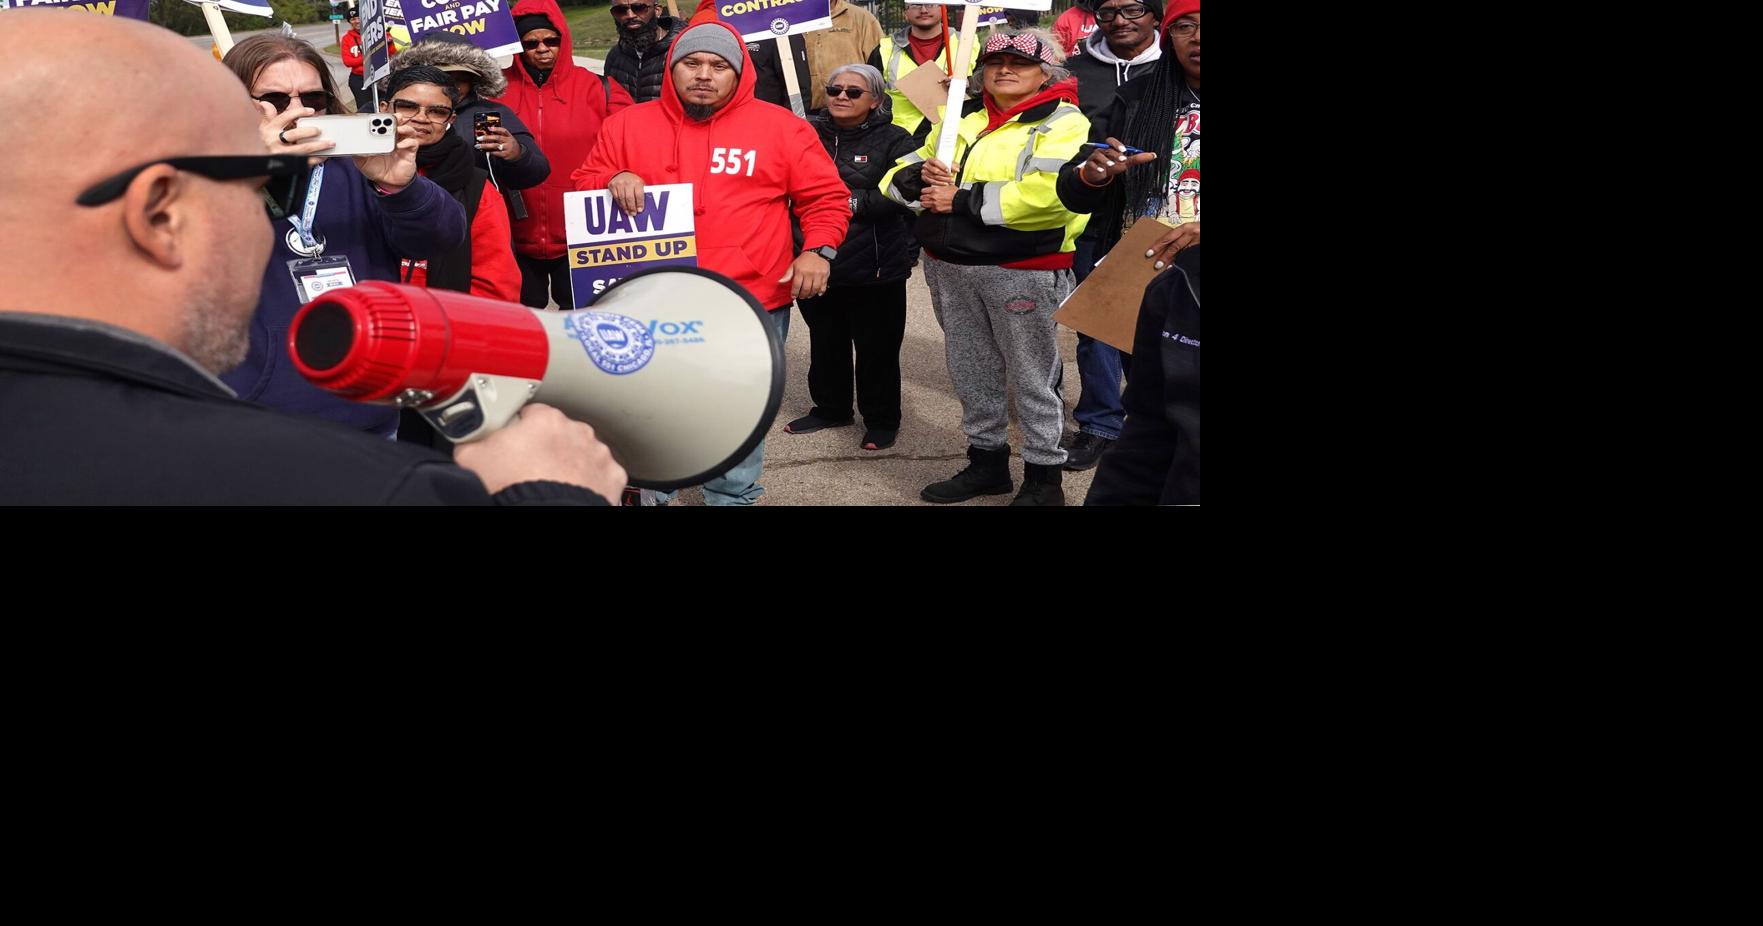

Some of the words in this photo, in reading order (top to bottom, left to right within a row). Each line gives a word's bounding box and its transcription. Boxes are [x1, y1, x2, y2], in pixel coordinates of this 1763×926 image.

[411, 10, 458, 33] FAIR
[460, 0, 500, 19] PAY
[445, 1, 461, 10] AND
[443, 18, 486, 35] OW
[710, 147, 756, 176] 551
[584, 190, 670, 235] UAW
[577, 244, 647, 265] STAND
[655, 240, 688, 257] UP
[599, 328, 627, 341] UAW
